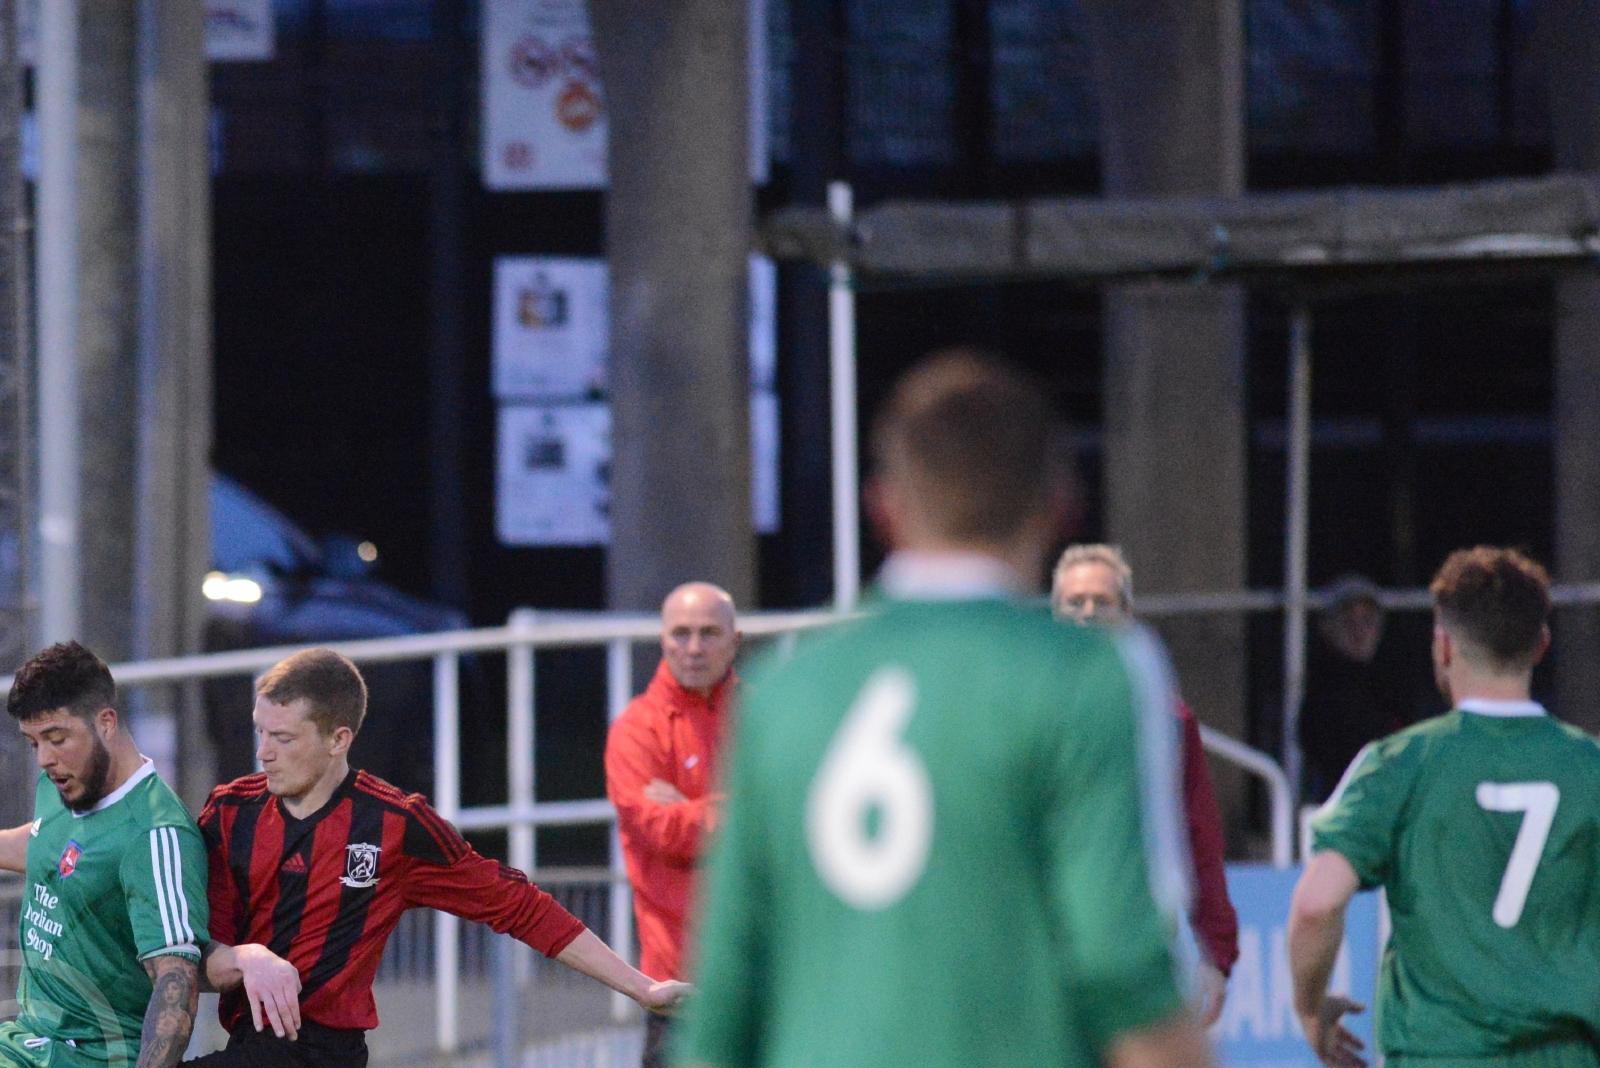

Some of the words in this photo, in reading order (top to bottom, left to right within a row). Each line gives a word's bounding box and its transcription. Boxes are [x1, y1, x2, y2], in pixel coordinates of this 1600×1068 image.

[804, 665, 936, 911] 6
[34, 883, 58, 909] The
[1476, 781, 1561, 929] 7
[25, 927, 53, 960] Shop
